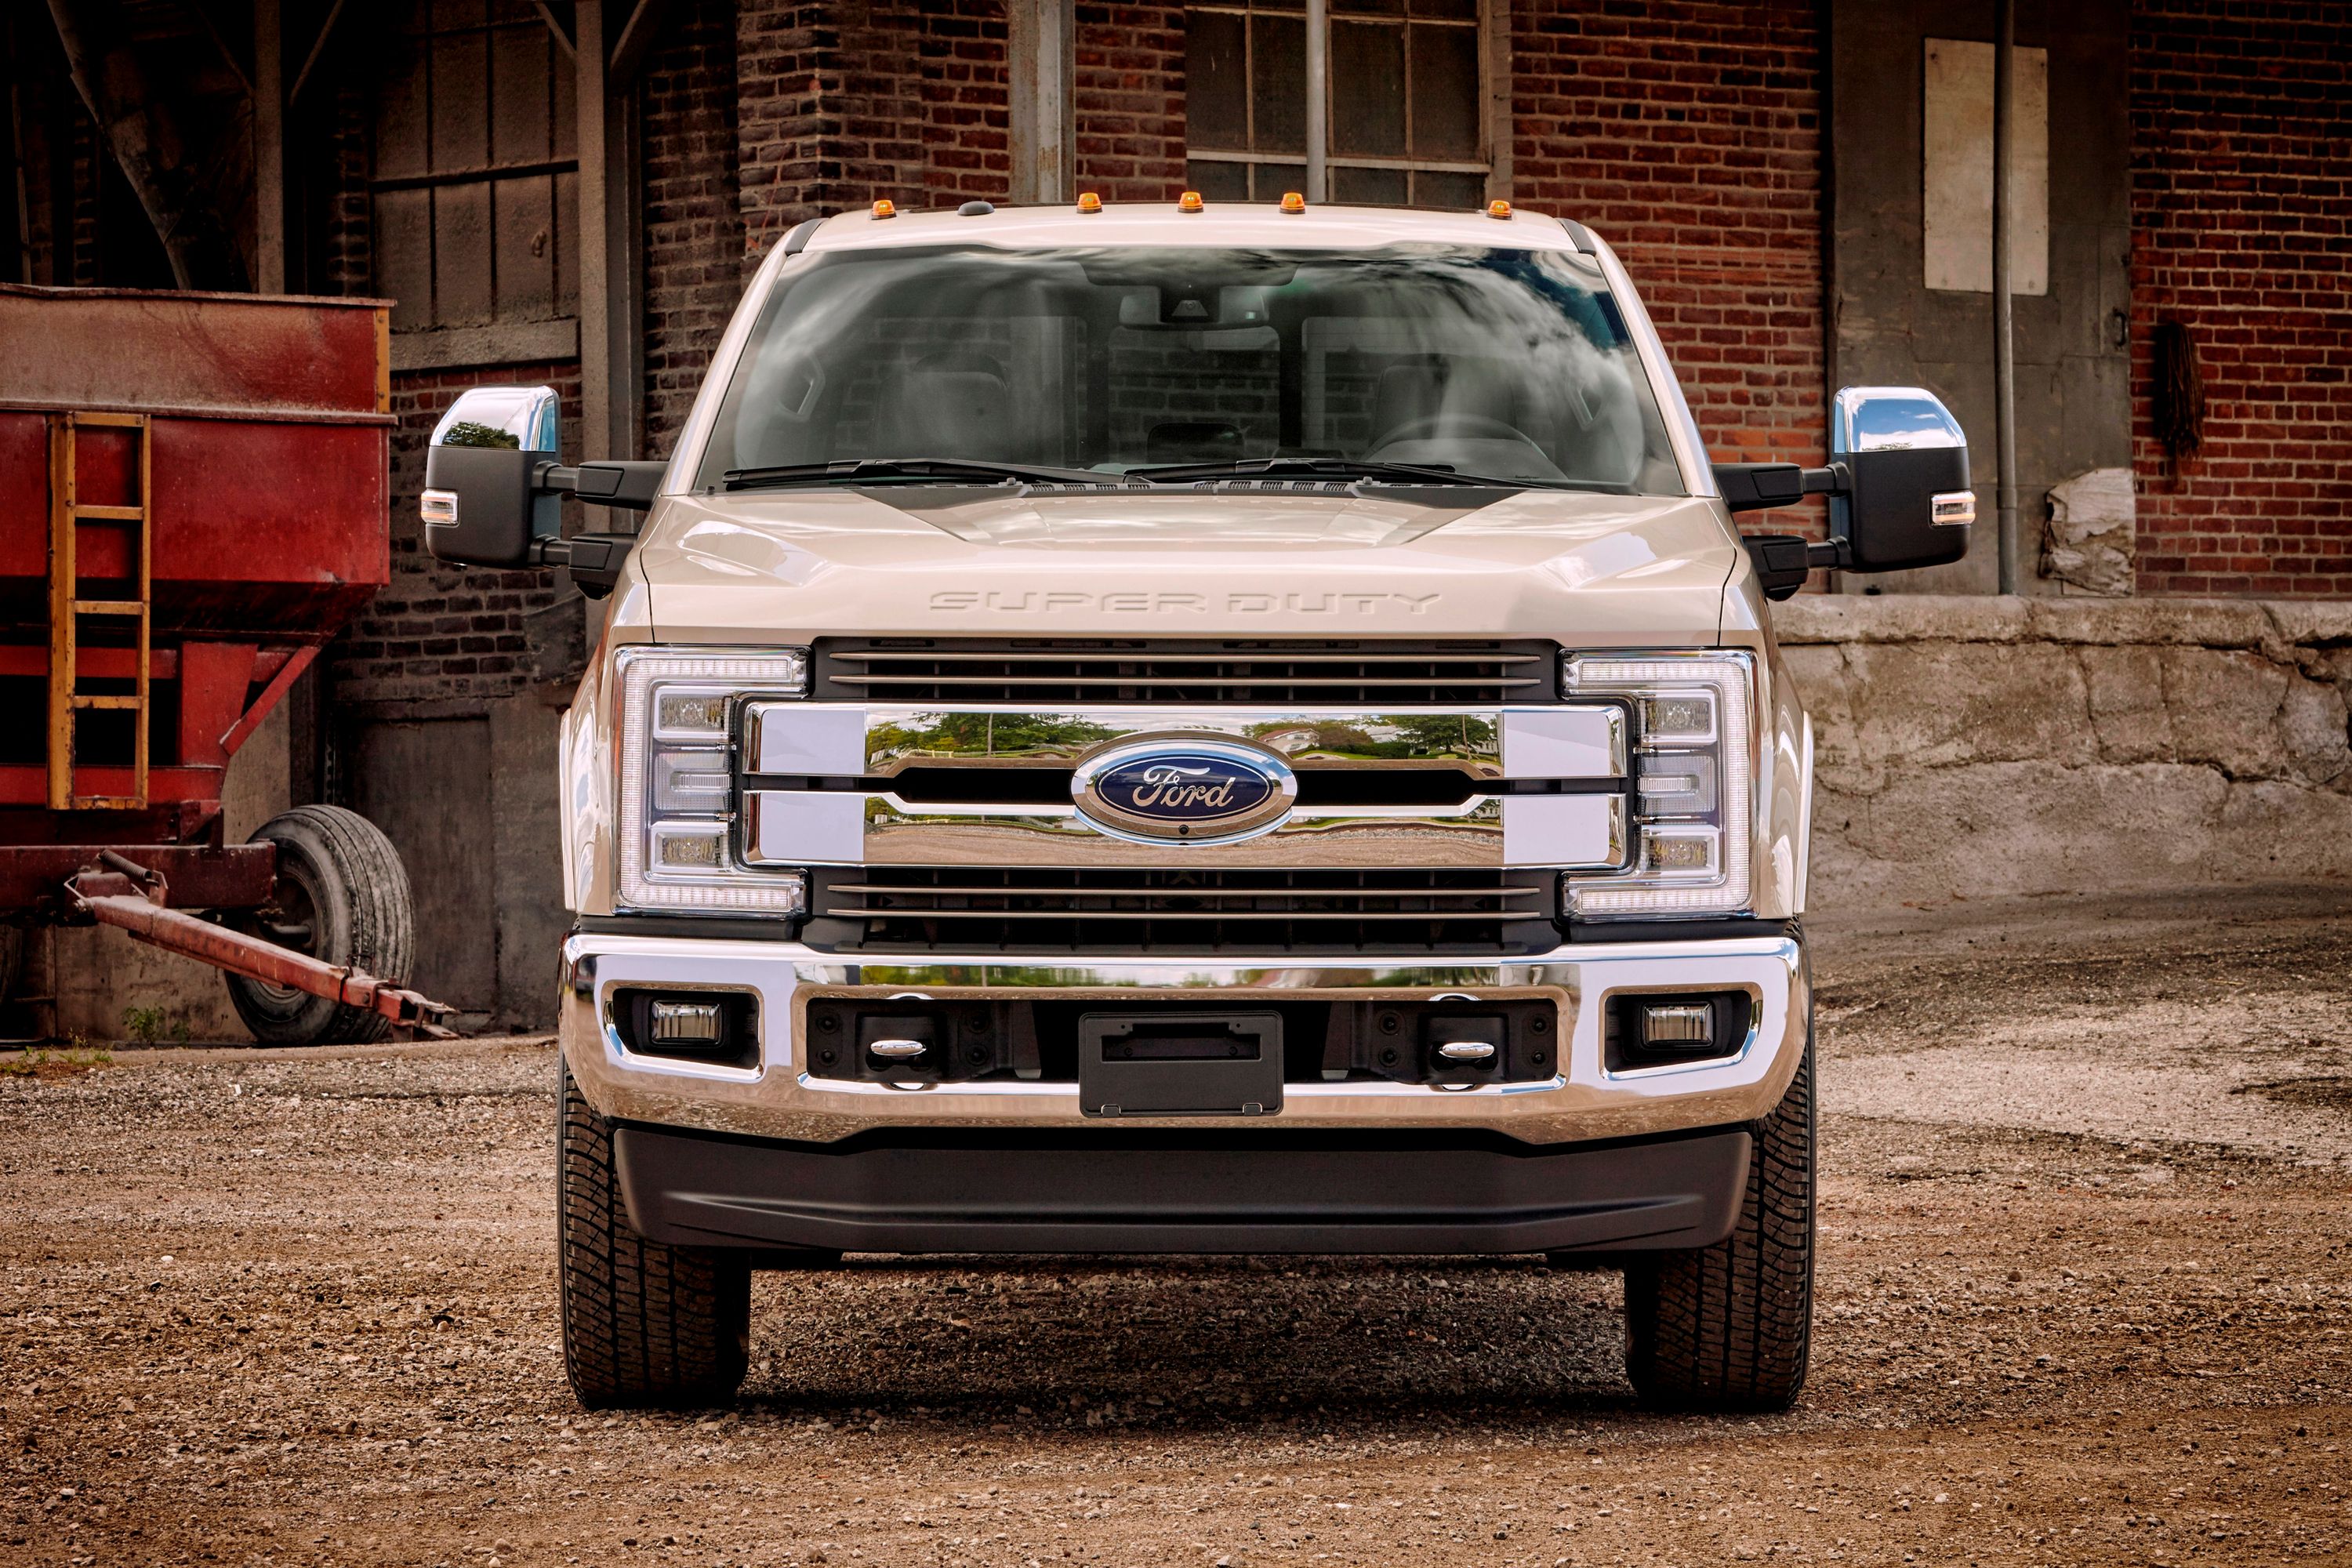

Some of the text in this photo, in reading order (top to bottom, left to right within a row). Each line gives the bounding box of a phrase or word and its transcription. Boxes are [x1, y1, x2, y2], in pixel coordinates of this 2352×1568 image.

[929, 592, 1442, 615] SUPER DUTY
[1132, 764, 1236, 807] Ford
